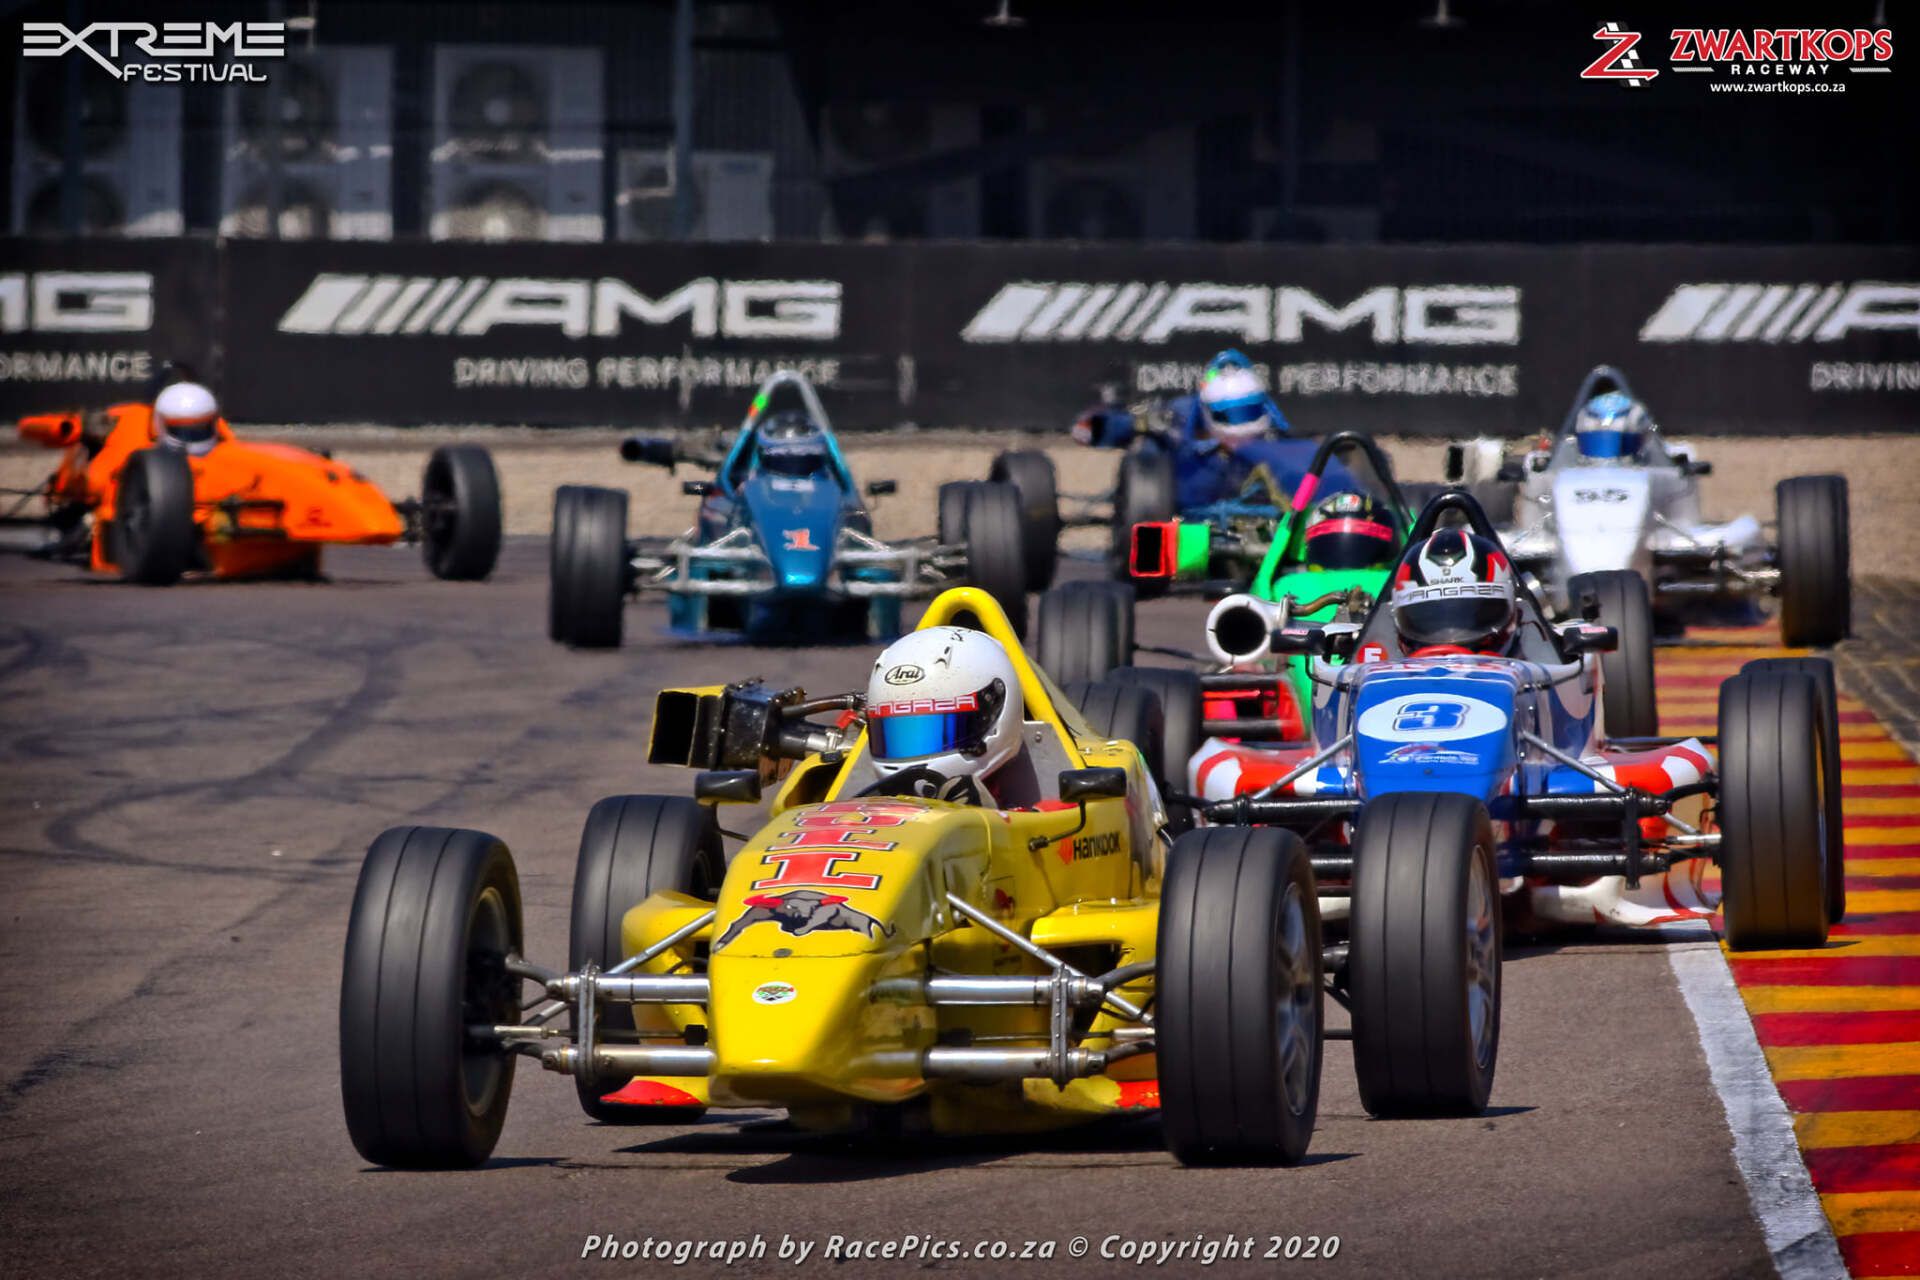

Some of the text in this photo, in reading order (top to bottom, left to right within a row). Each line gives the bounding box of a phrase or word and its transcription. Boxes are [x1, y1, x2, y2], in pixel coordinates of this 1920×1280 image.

[456, 276, 843, 340] AMG
[1142, 280, 1521, 346] AMG
[454, 357, 591, 389] DRIVING
[1137, 360, 1519, 397] DRIG PERFORMANCE
[1430, 576, 1464, 586] SHARK
[886, 667, 921, 680] Arai
[1392, 701, 1470, 732] 3
